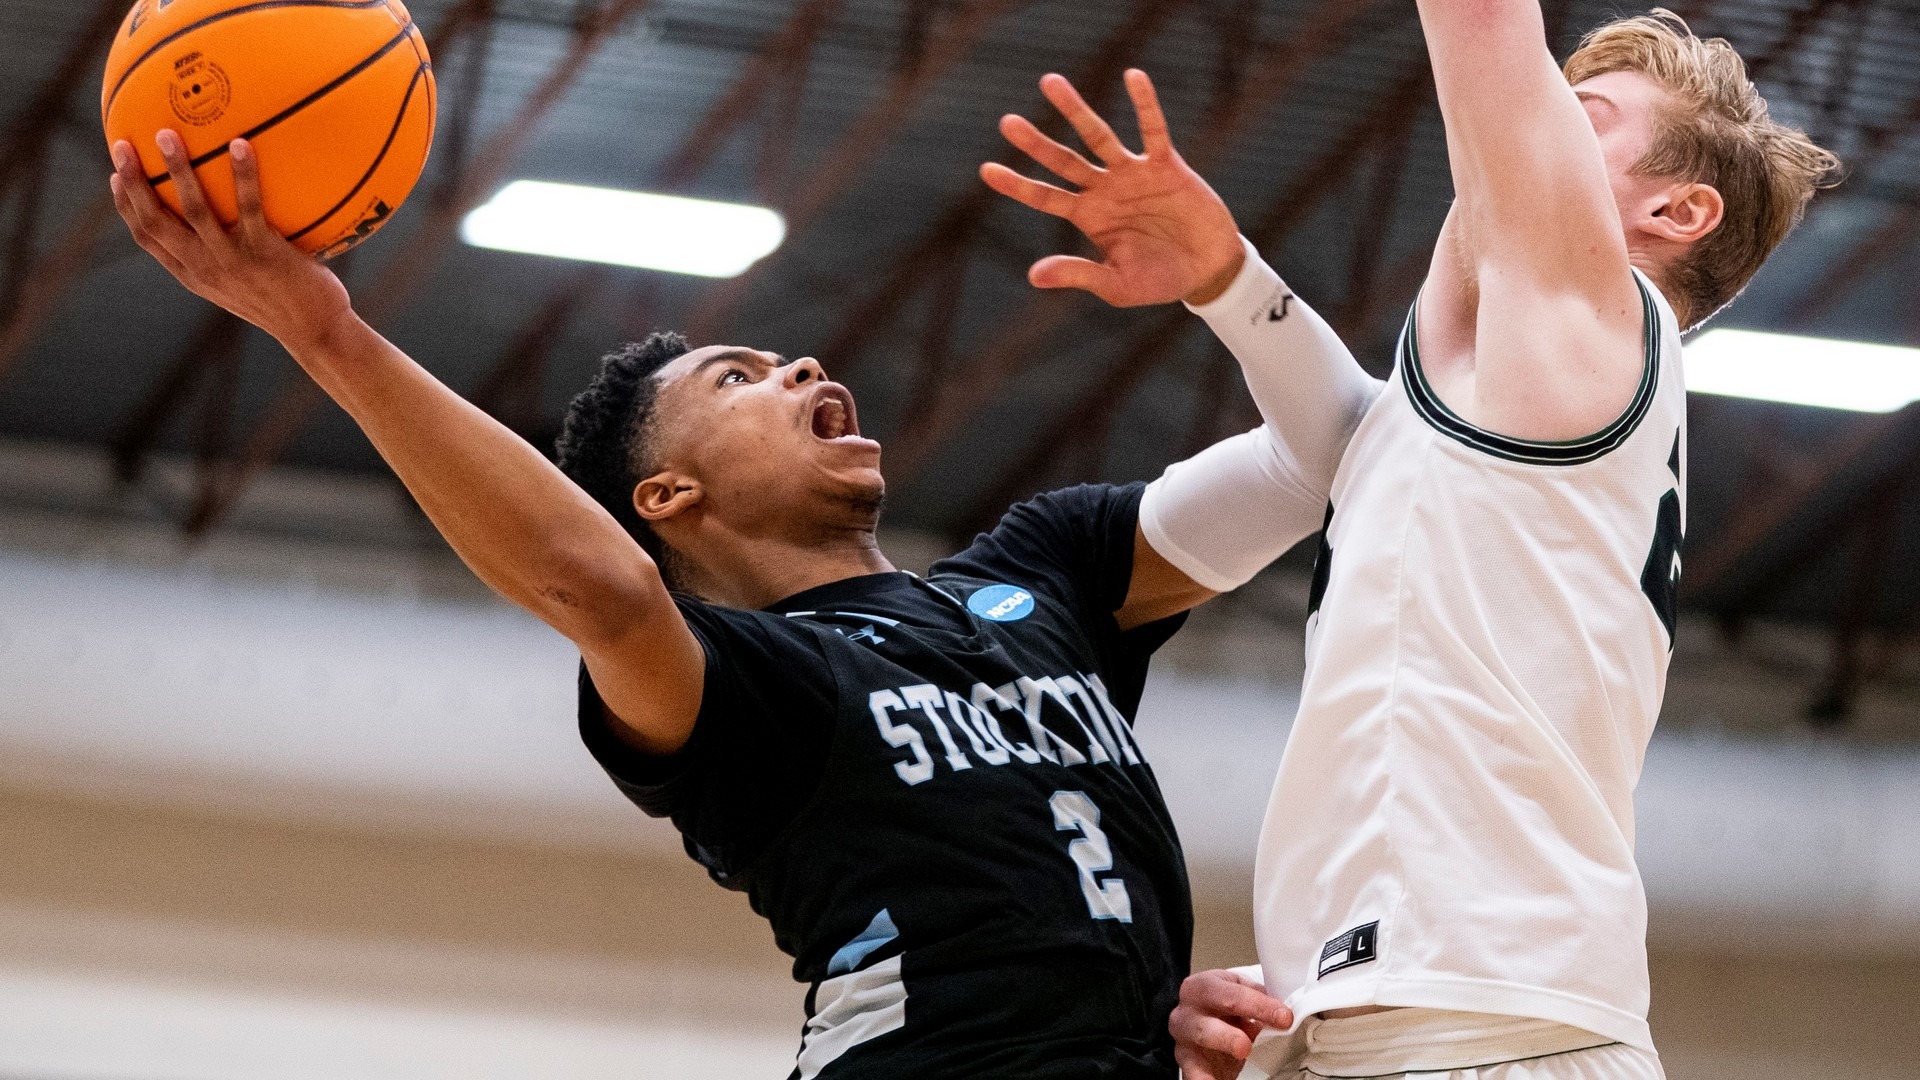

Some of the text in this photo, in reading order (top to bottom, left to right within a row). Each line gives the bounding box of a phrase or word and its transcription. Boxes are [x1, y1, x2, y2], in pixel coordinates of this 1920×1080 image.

[986, 591, 1031, 618] NCAA
[1049, 790, 1133, 923] 2
[1357, 935, 1366, 951] L
